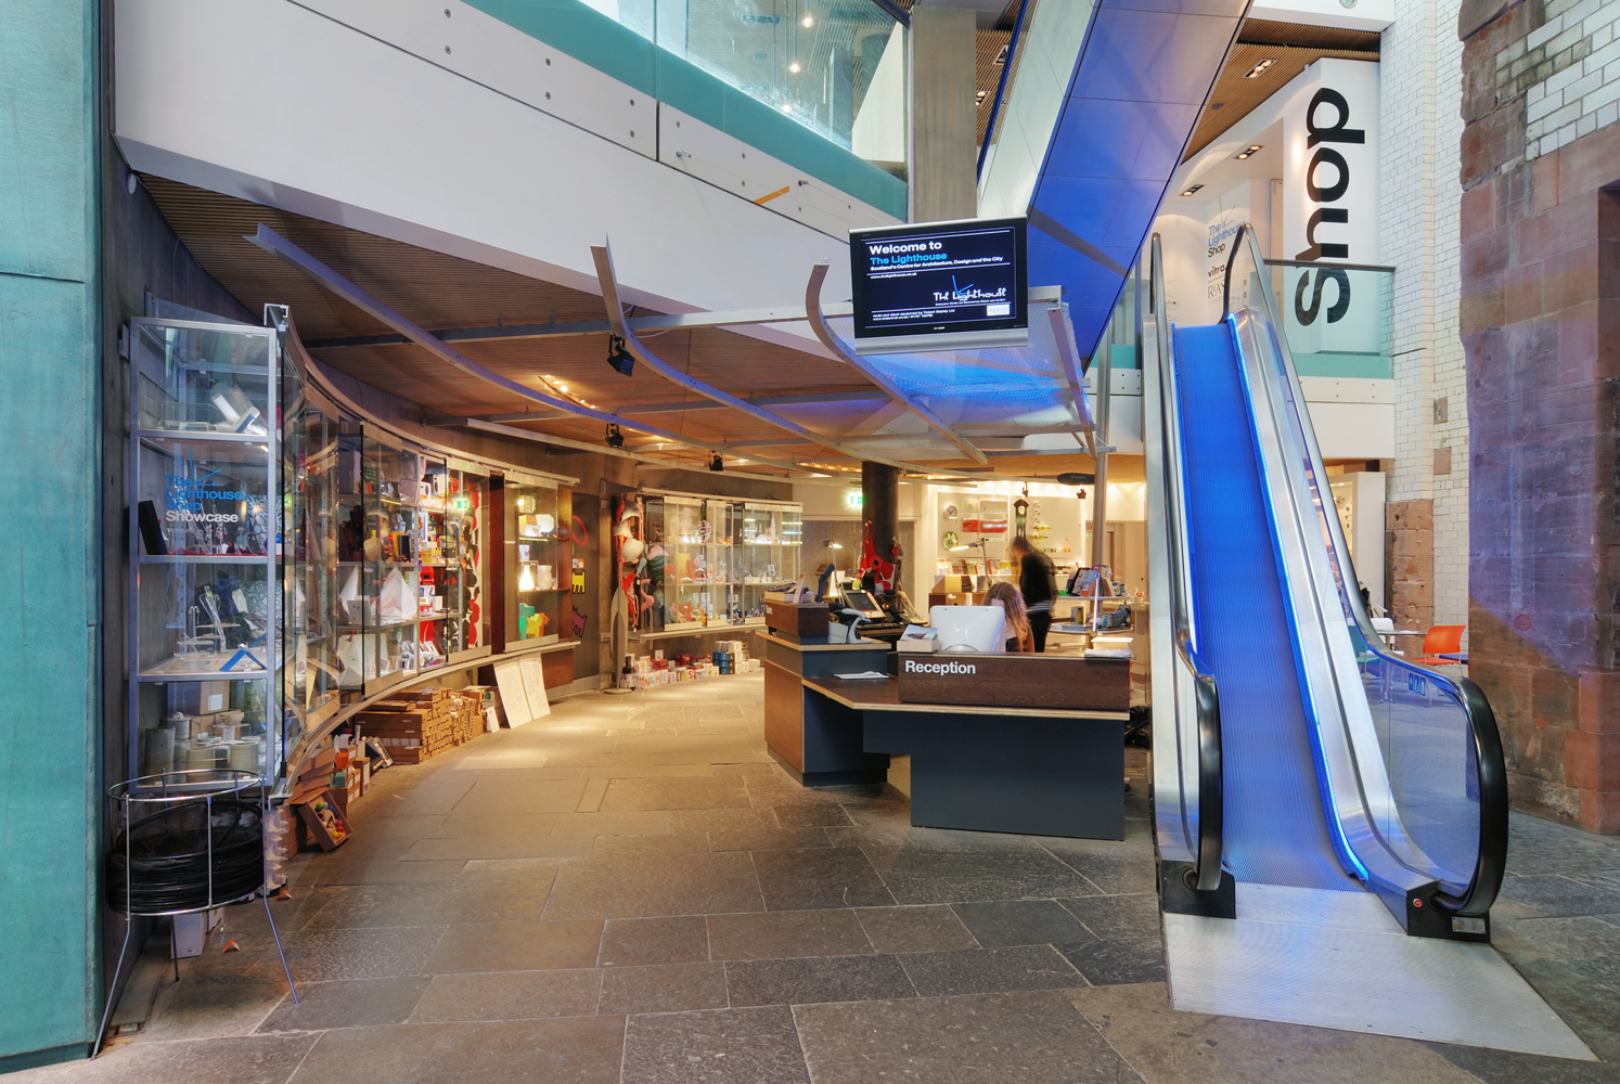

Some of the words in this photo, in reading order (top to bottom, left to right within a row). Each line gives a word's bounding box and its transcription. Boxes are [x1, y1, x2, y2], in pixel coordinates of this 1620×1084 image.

[1295, 87, 1365, 327] Shop
[1208, 223, 1221, 236] The
[869, 243, 927, 255] Welcome
[928, 241, 942, 250] to
[1208, 243, 1226, 258] Shop
[870, 257, 889, 265] The
[891, 253, 948, 265] Lighthouse
[165, 475, 192, 488] The
[165, 487, 243, 501] Lighthouse
[165, 499, 202, 513] Shop
[165, 510, 239, 523] Showcase
[905, 660, 976, 676] Reception
